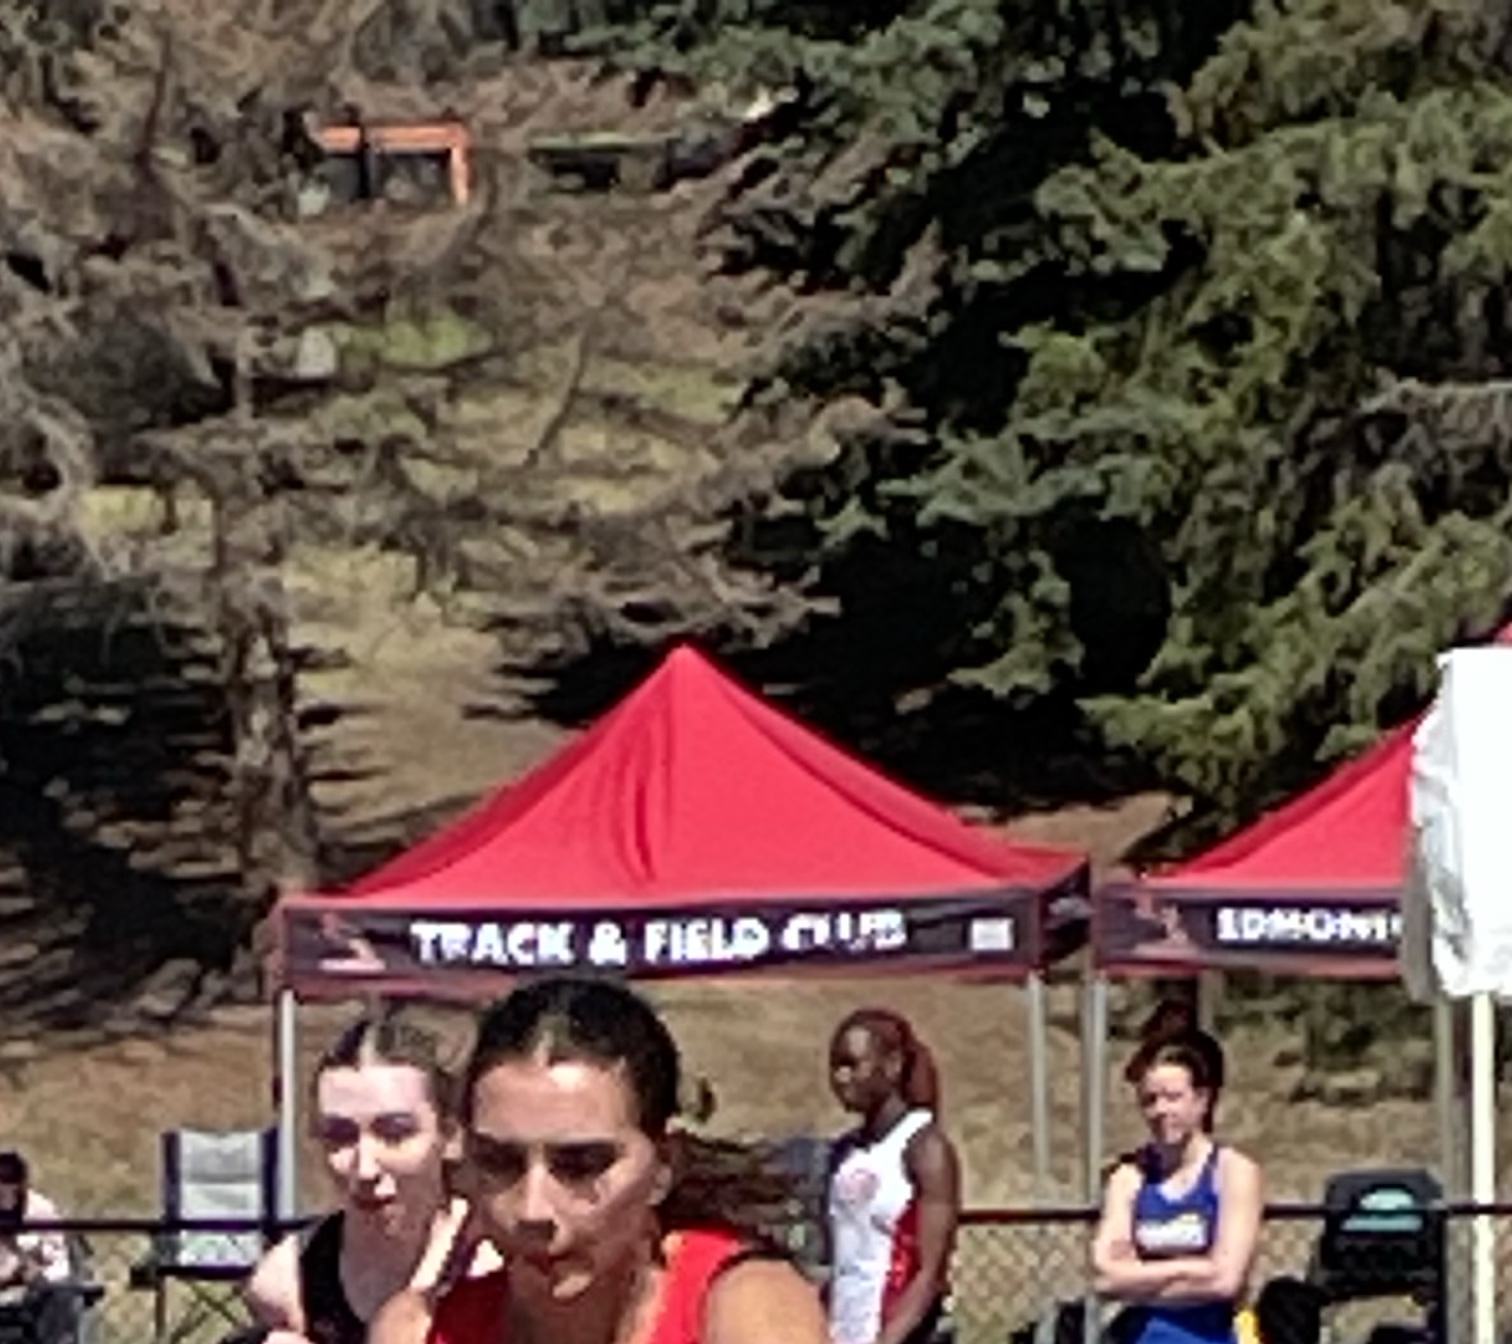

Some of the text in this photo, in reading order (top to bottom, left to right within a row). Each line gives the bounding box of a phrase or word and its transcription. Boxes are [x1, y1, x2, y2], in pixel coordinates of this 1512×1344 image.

[410, 922, 575, 965] TRACK
[589, 921, 626, 965] &
[644, 917, 770, 962] FIELD
